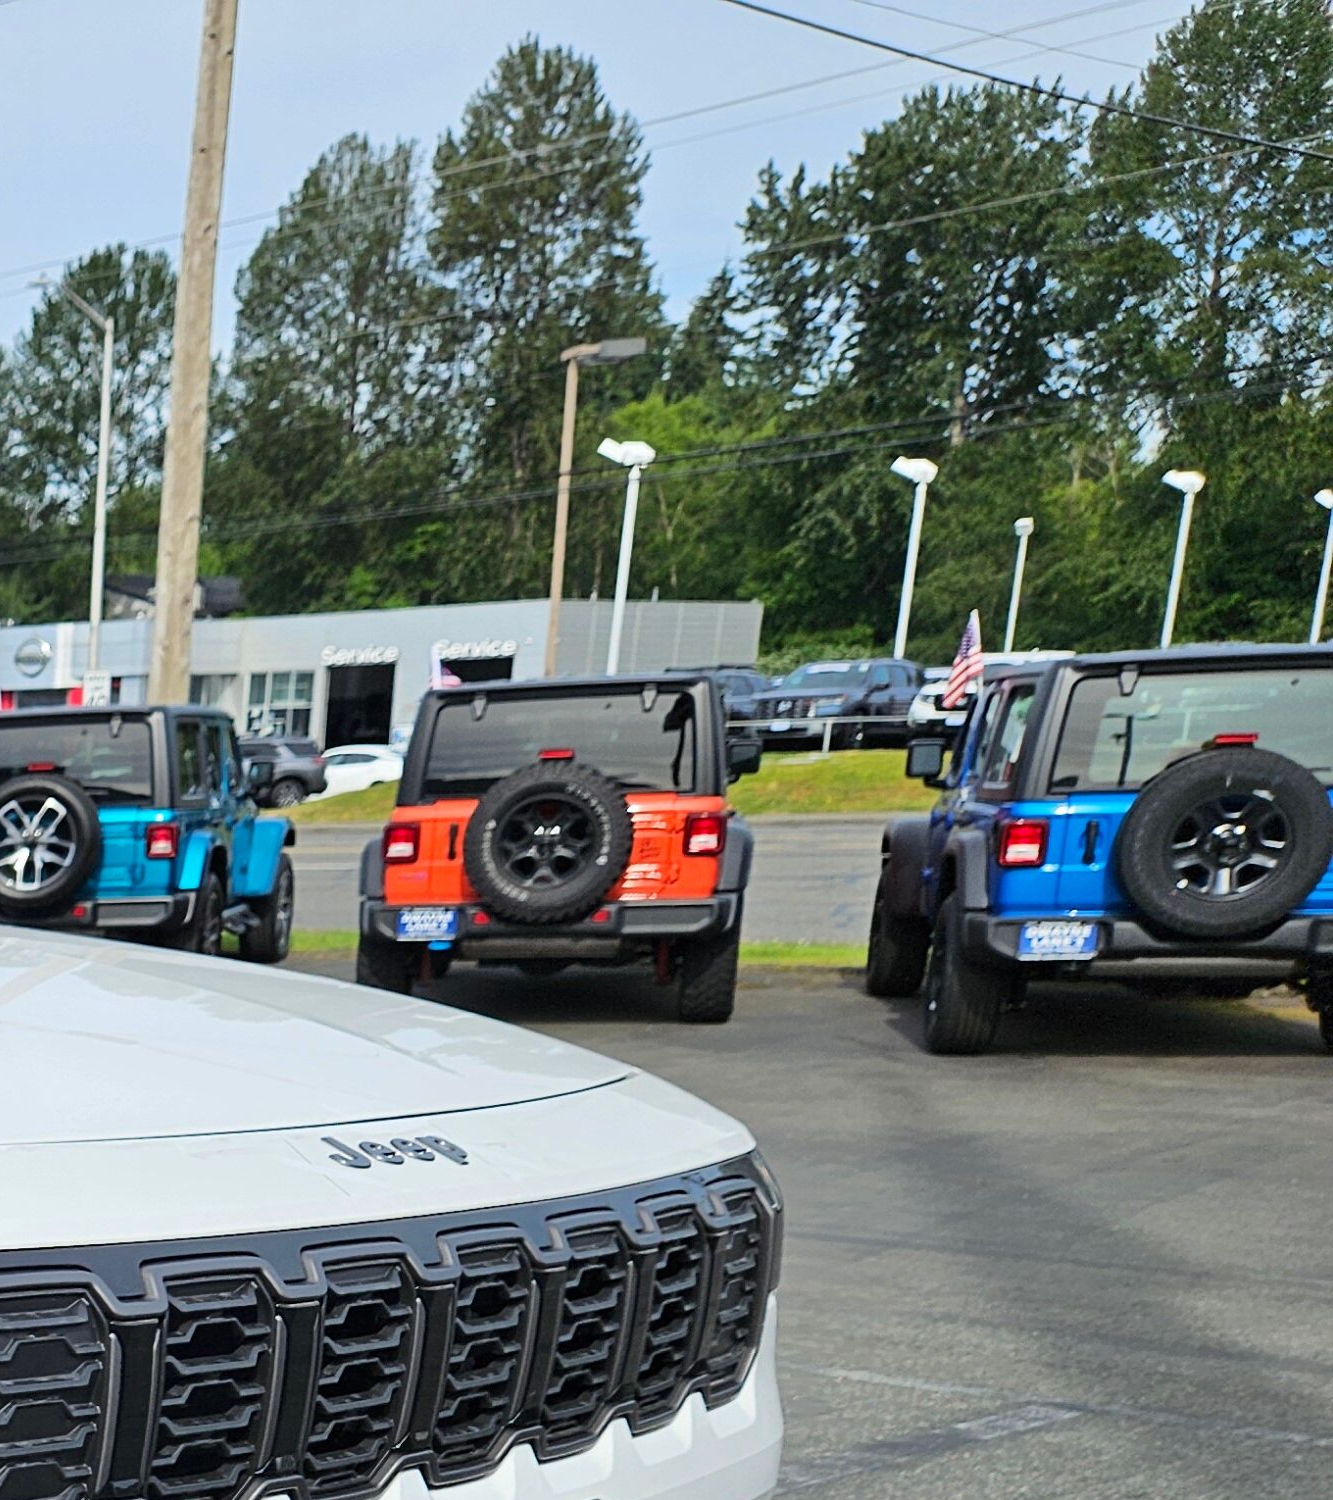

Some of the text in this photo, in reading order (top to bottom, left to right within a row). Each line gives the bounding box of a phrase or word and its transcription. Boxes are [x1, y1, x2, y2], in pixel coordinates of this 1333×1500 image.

[321, 644, 399, 666] Service
[432, 638, 518, 661] Service
[320, 1135, 470, 1169] Jeep
